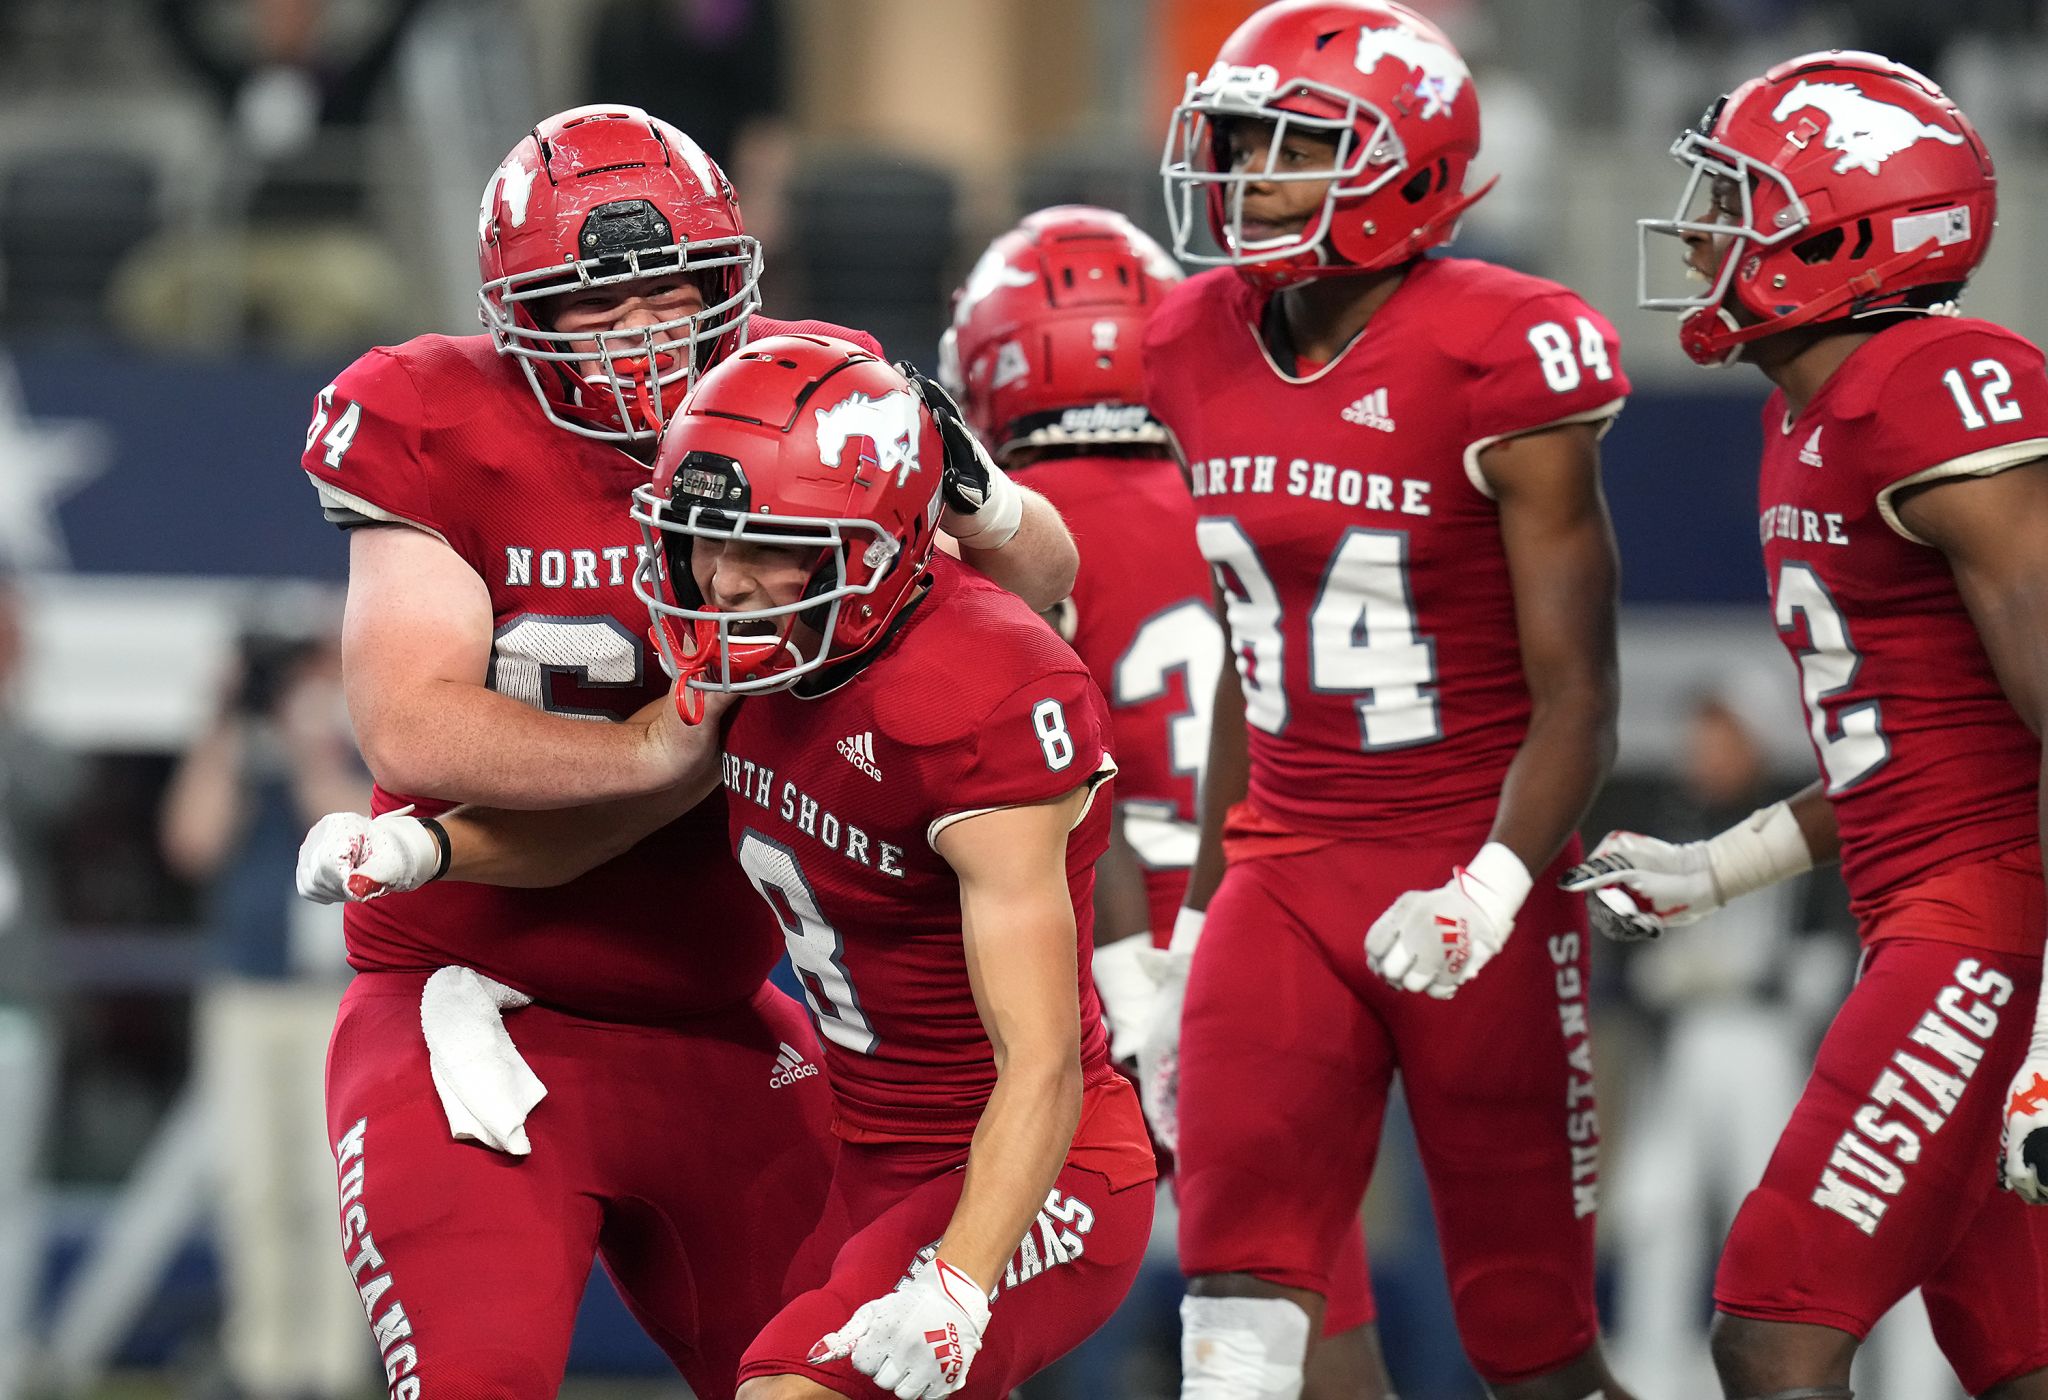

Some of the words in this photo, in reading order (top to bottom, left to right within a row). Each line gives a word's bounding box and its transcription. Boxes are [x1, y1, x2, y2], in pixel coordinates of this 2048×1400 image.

[1526, 315, 1615, 394] 84
[1942, 357, 2023, 431] 12
[306, 384, 362, 471] 64
[1286, 457, 1432, 516] SHORE
[1194, 514, 1444, 752] 84
[836, 740, 882, 782] adidas
[1031, 697, 1075, 773] 8
[721, 751, 775, 811] ORTH
[780, 779, 906, 879] SHORE
[737, 826, 881, 1056] 8
[769, 1063, 819, 1089] adidas
[1547, 931, 1600, 1220] MUSTANGS
[1811, 957, 2016, 1238] MUSTANGS
[945, 1321, 963, 1384] adidas
